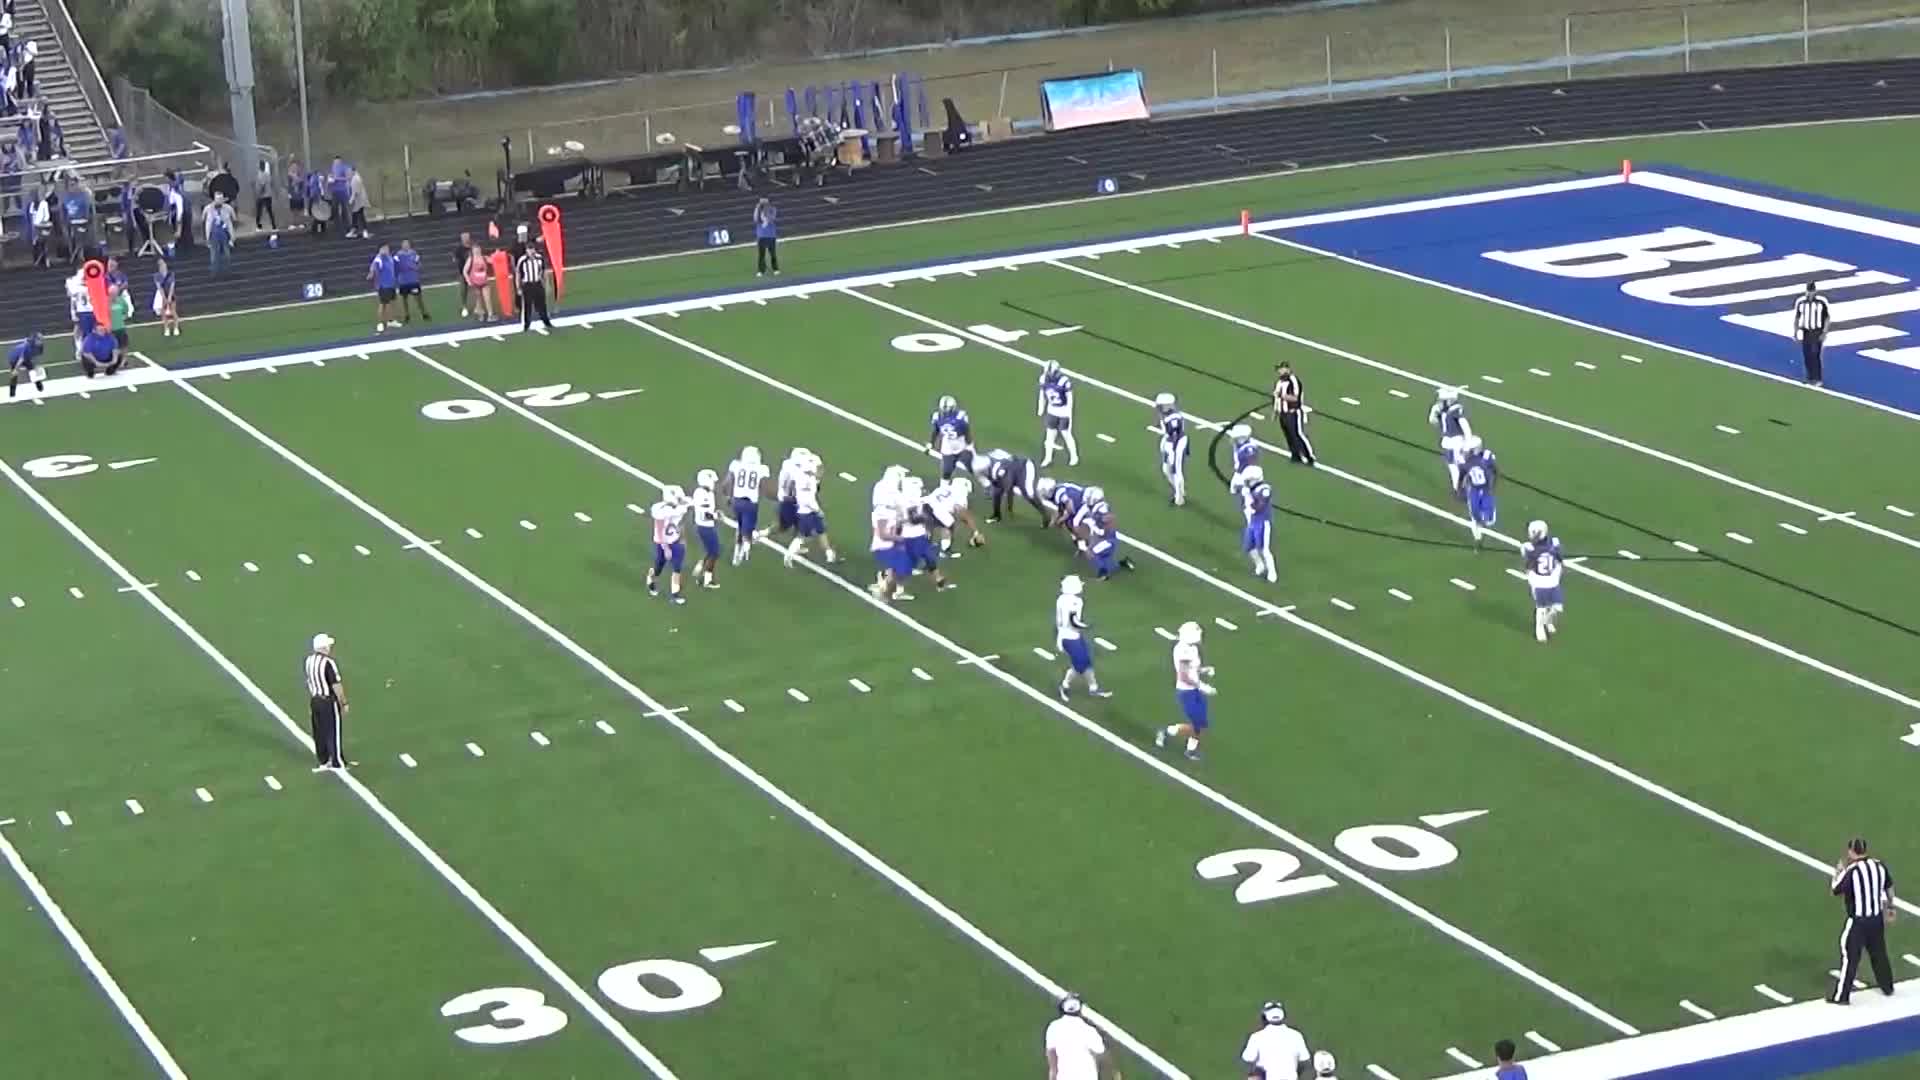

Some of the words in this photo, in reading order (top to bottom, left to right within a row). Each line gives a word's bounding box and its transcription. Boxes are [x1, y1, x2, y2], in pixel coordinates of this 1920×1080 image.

[712, 228, 730, 244] 10
[306, 282, 324, 298] 20
[422, 384, 590, 421] 20
[736, 468, 758, 490] 88
[1537, 551, 1556, 576] 21
[1197, 825, 1458, 905] 20
[441, 959, 722, 1044] 30
